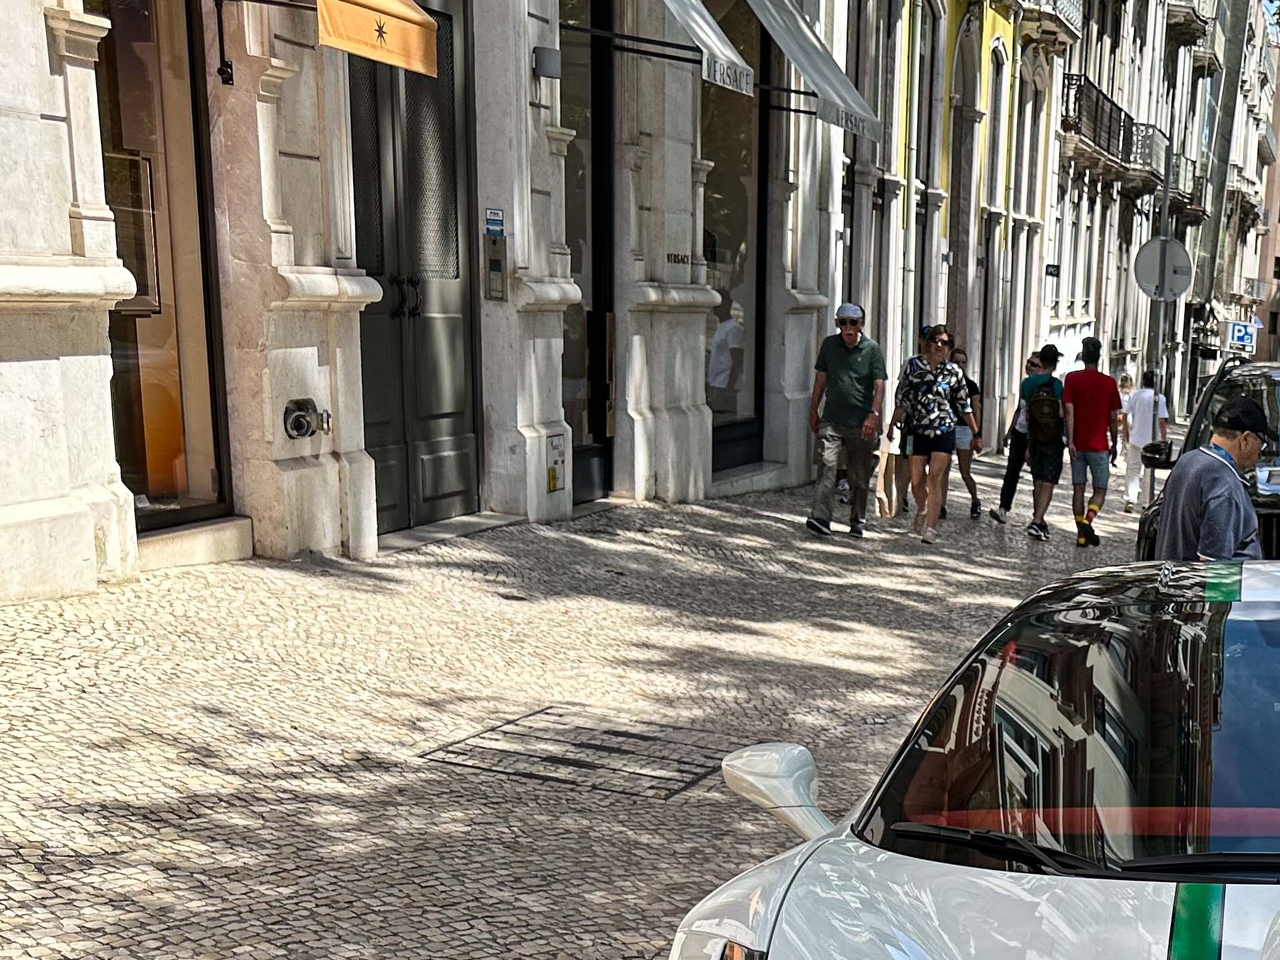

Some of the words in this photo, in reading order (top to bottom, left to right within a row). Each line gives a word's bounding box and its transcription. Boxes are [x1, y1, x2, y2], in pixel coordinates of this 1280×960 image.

[706, 57, 750, 93] VERSACE
[835, 109, 867, 136] VERSACE
[1233, 325, 1246, 342] P
